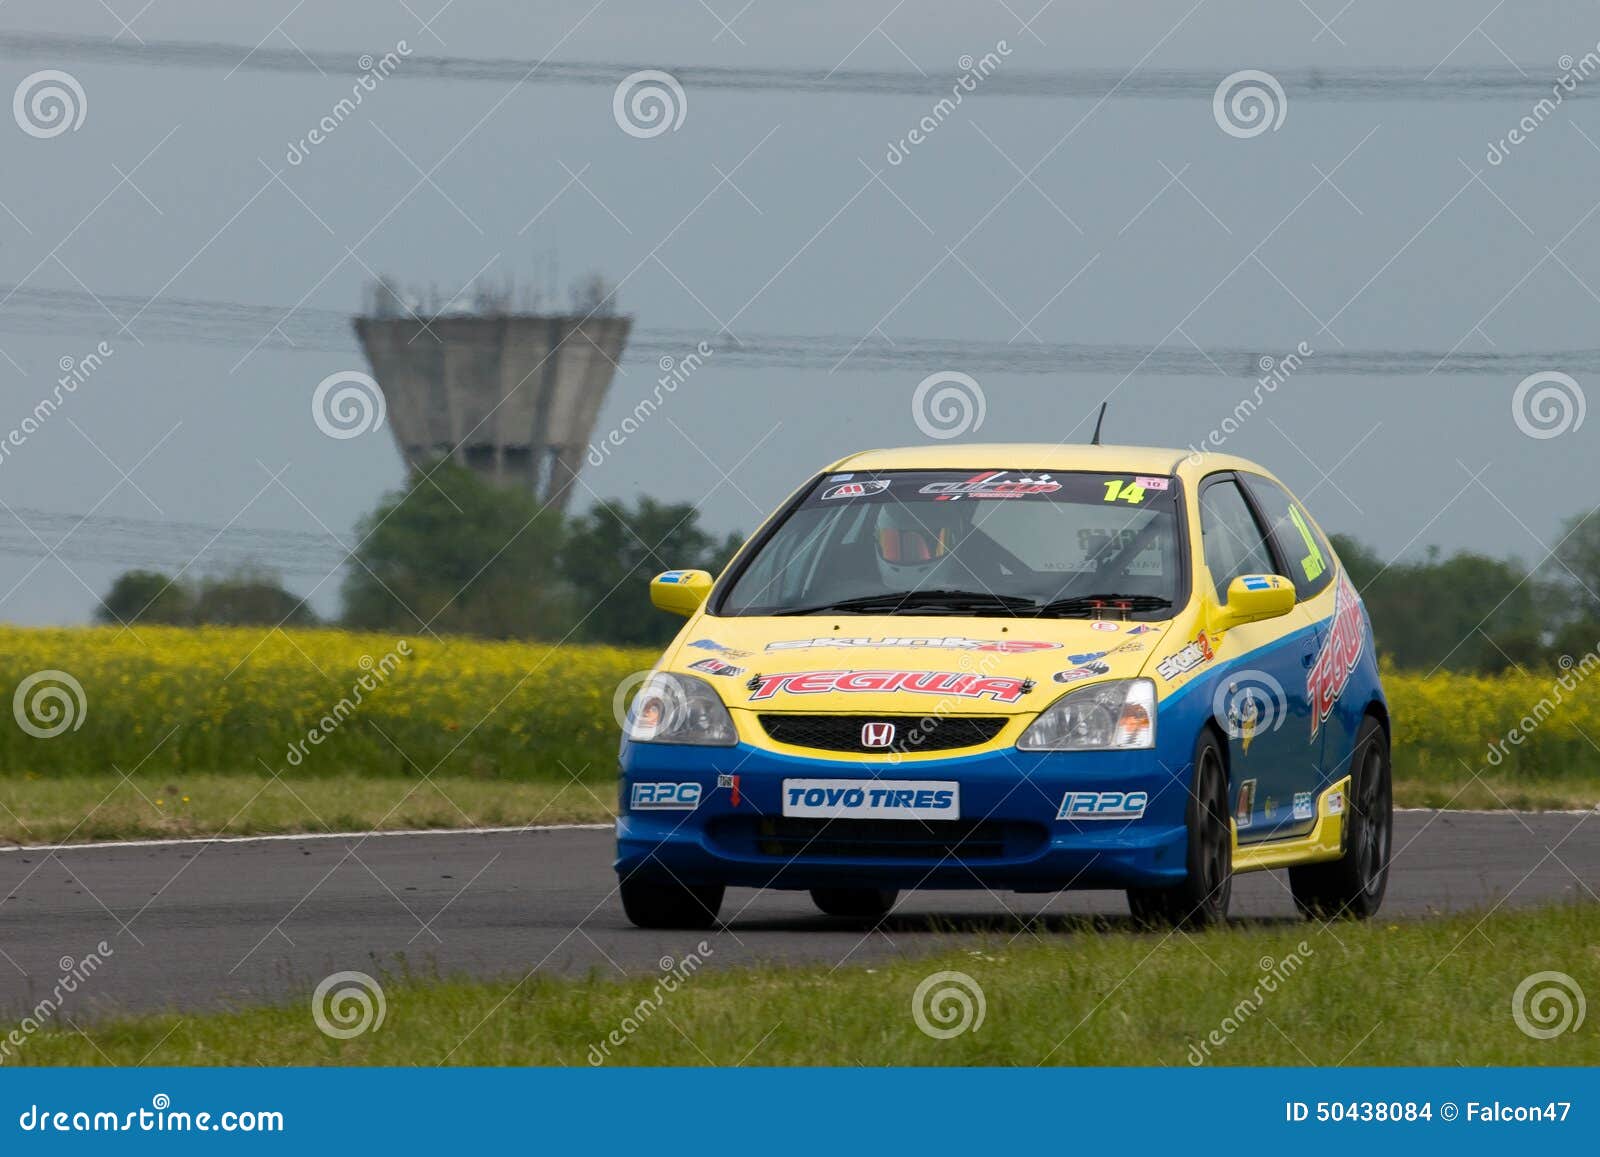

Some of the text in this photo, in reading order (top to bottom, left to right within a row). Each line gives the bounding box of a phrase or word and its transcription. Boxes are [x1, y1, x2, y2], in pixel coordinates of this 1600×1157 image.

[1104, 480, 1146, 504] 14
[750, 671, 1035, 703] TEGIWA
[788, 788, 954, 809] TOYO TIRES
